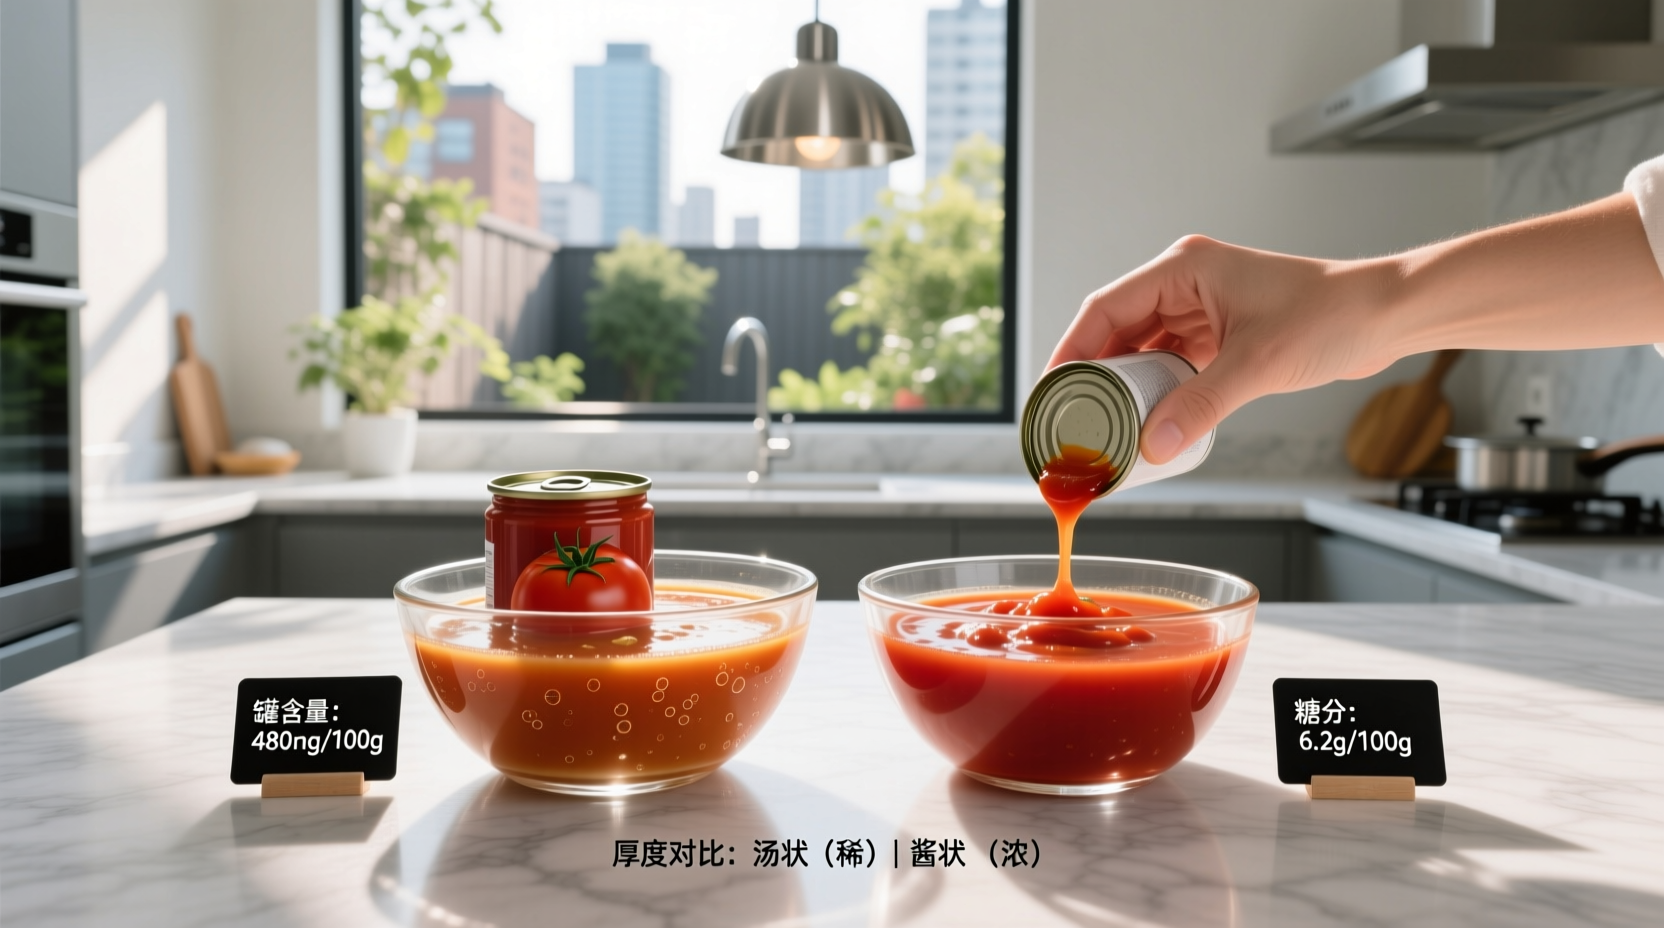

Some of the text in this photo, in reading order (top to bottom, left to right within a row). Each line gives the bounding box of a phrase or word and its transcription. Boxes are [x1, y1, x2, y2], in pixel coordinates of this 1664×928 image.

[1294, 697, 1356, 725] 糖分：
[251, 728, 384, 756] 480ng/100g
[1299, 729, 1412, 758] 6.2g/100g
